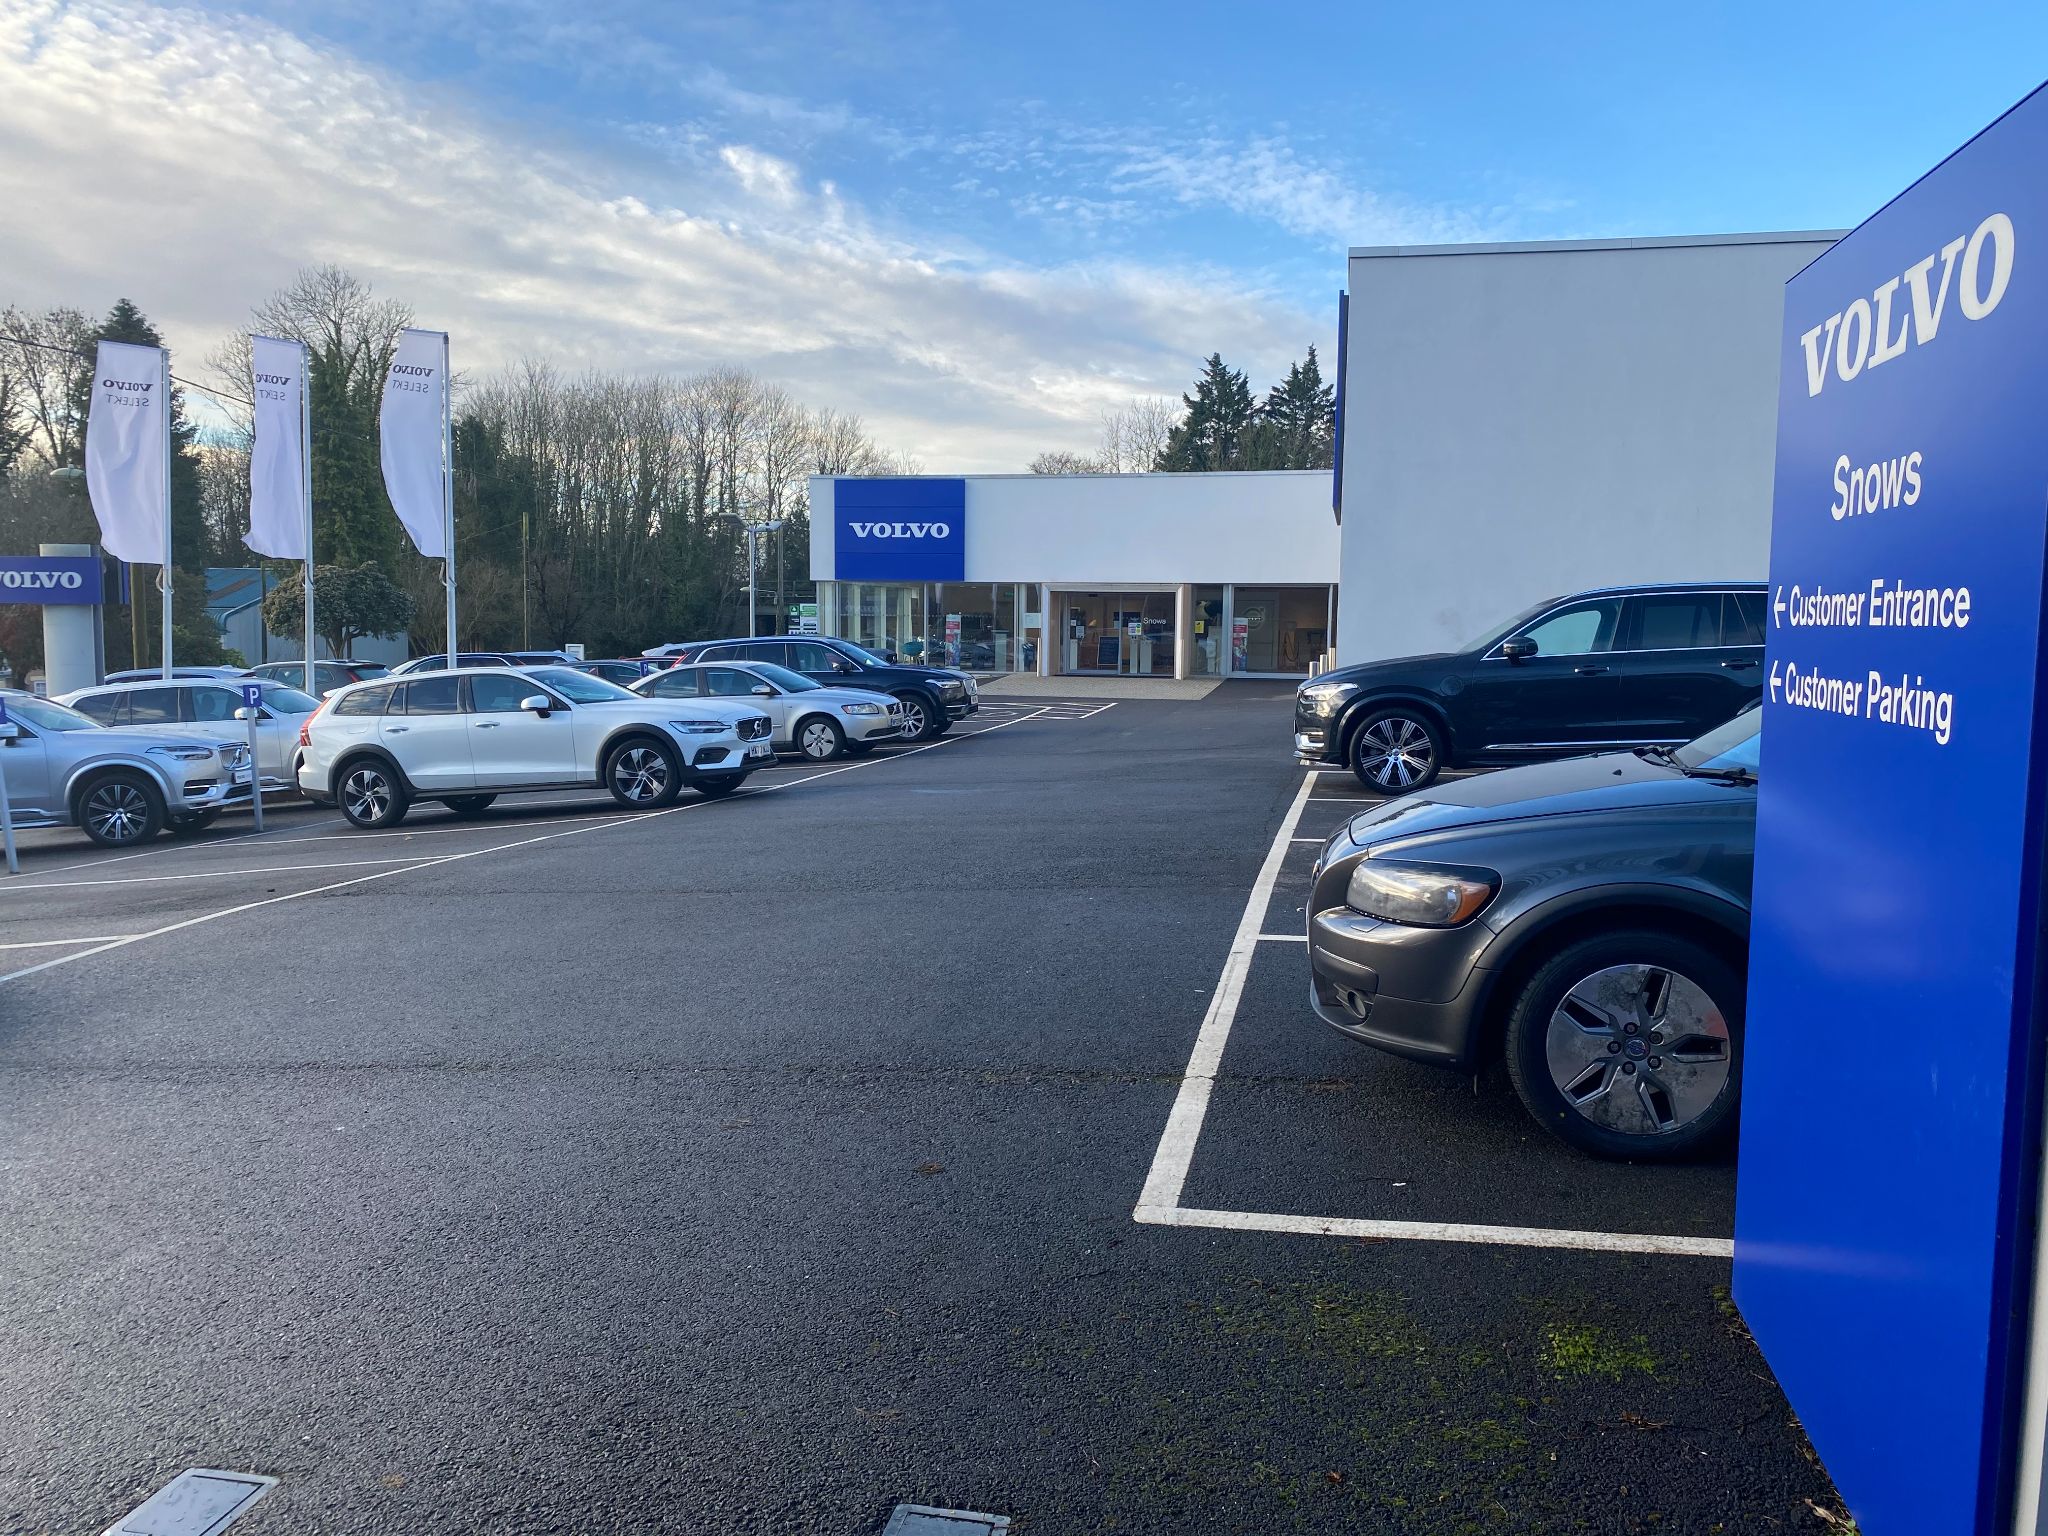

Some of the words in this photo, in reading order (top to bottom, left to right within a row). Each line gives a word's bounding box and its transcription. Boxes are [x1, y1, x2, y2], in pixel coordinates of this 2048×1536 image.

[1802, 213, 2014, 397] VOLVO
[1831, 452, 1922, 520] Snows
[849, 523, 949, 538] VOLVO
[0, 571, 82, 588] OLVO
[1790, 585, 1865, 626] Customer
[1870, 579, 1970, 627] Entrance
[1143, 617, 1167, 625] Snows
[249, 688, 259, 704] P
[1786, 663, 1861, 716] Customer
[1867, 671, 1952, 744] Parking
